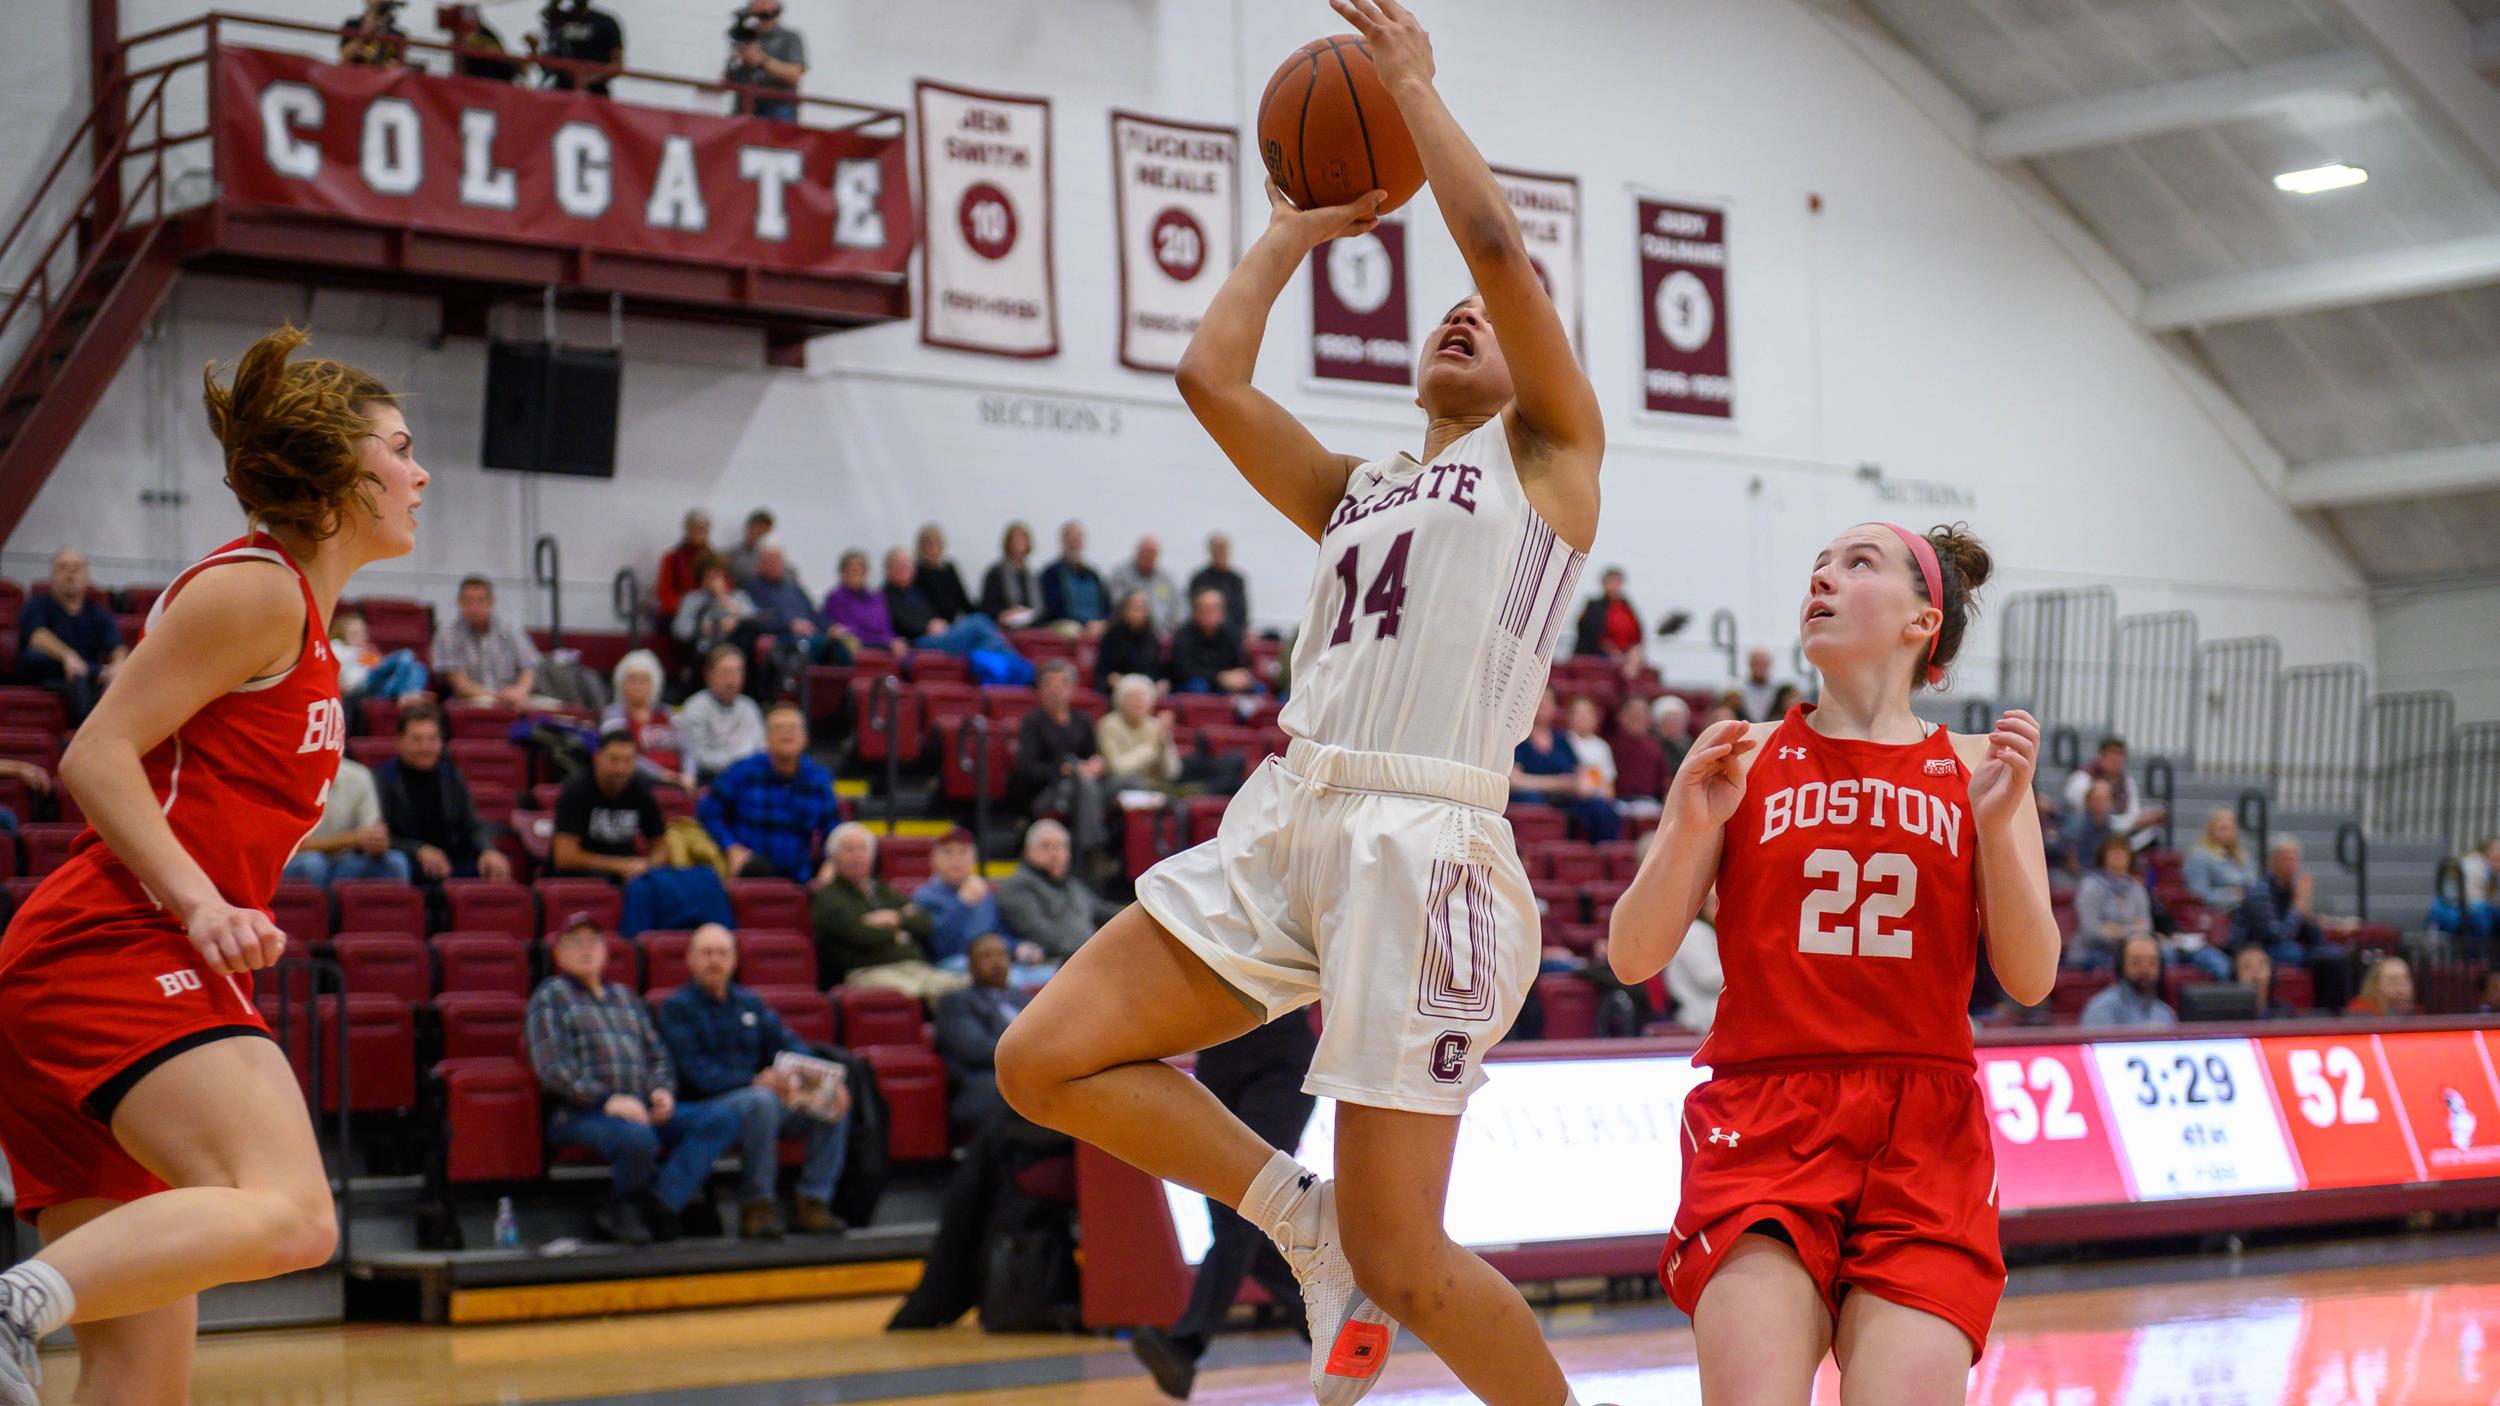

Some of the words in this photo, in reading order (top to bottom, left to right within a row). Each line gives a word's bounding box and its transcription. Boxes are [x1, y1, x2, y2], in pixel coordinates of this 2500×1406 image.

[259, 79, 888, 249] COLGATE
[944, 135, 1031, 168] SMITH
[1158, 222, 1200, 268] 20
[977, 392, 1102, 434] SECTION
[1329, 528, 1416, 648] 14
[1760, 778, 1962, 858] BOSTON
[1798, 848, 1918, 960] 22
[155, 969, 202, 997] BU
[1985, 1057, 2089, 1144] 52
[2127, 1053, 2237, 1107] 3:29
[2287, 1046, 2380, 1128] 52
